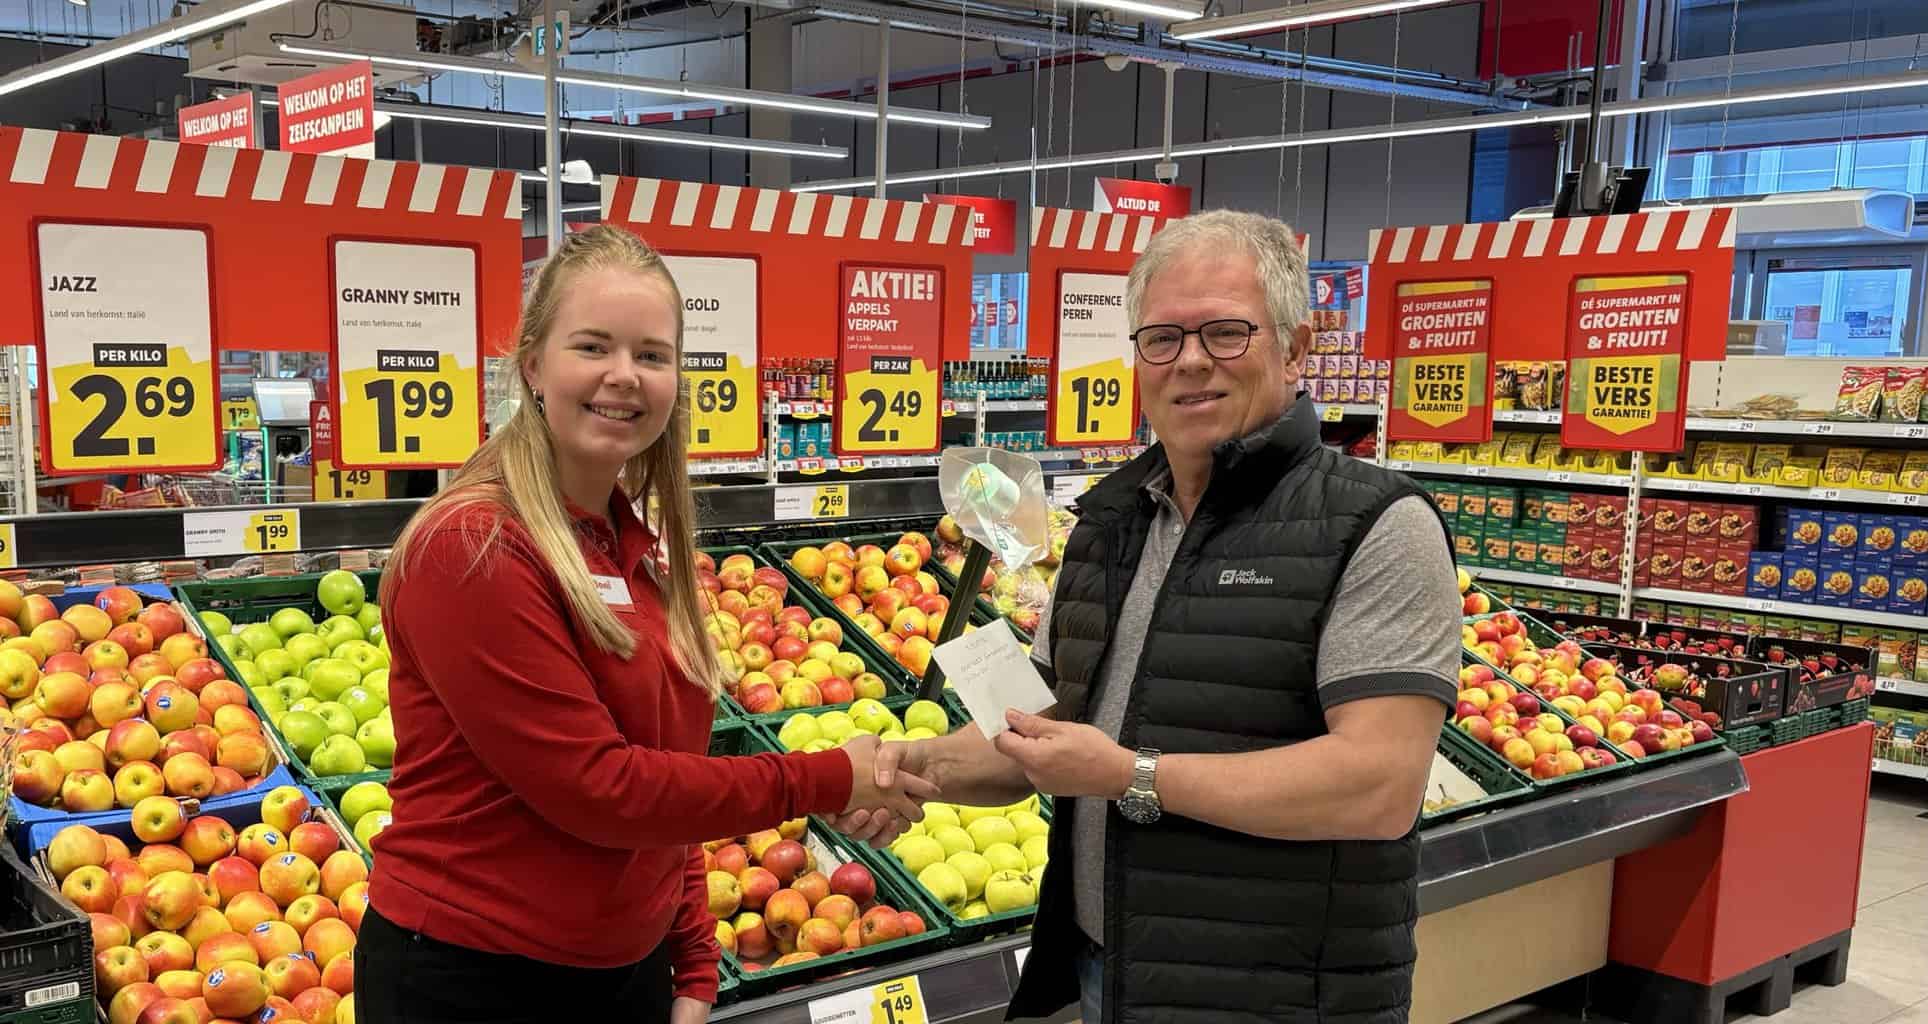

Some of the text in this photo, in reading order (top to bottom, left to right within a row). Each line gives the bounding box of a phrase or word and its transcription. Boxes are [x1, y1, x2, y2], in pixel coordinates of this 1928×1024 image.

[284, 75, 366, 116] WELKOM OP HET
[184, 107, 248, 138] WELKOM OP HET
[288, 107, 364, 144] ZELFSCANPLEIN
[1148, 199, 1160, 212] DE
[48, 276, 97, 292] JAZZ
[850, 270, 935, 301] AKTIE!
[341, 287, 461, 306] GRANNY SMITH
[682, 298, 720, 312] GOLD
[1063, 293, 1122, 306] CONFERENCE
[1402, 297, 1487, 313] DÉ SUPERMARKT IN
[1581, 294, 1681, 310] DÉ SUPERMARKT IN
[847, 302, 891, 315] APPELS
[1063, 308, 1093, 320] PEREN
[847, 318, 899, 332] VERPAKT
[1401, 310, 1486, 331] GROENTEN
[1580, 308, 1680, 330] GROENTEN
[1408, 330, 1476, 349] & FRUIT!
[1587, 330, 1668, 349] & FRUIT!
[99, 350, 162, 362] PER KILO
[382, 356, 436, 368] PER KILO
[682, 357, 723, 367] PER KILO
[874, 360, 909, 370] PER ZAK
[1415, 364, 1465, 380] BESTE
[1594, 366, 1653, 384] BESTE
[1414, 383, 1464, 401] VERS
[1594, 386, 1651, 406] VERS
[1071, 377, 1121, 433] 1.99
[1413, 402, 1464, 413] GARANTIE!
[1592, 407, 1650, 419] GARANTIE!
[69, 374, 195, 457] 2.69
[364, 378, 454, 453] 1.99
[858, 388, 922, 442] 2.49
[818, 495, 843, 516] 2.69
[256, 524, 288, 550] 1.99
[1235, 575, 1273, 585] Wolfskin
[1237, 568, 1257, 577] Jack
